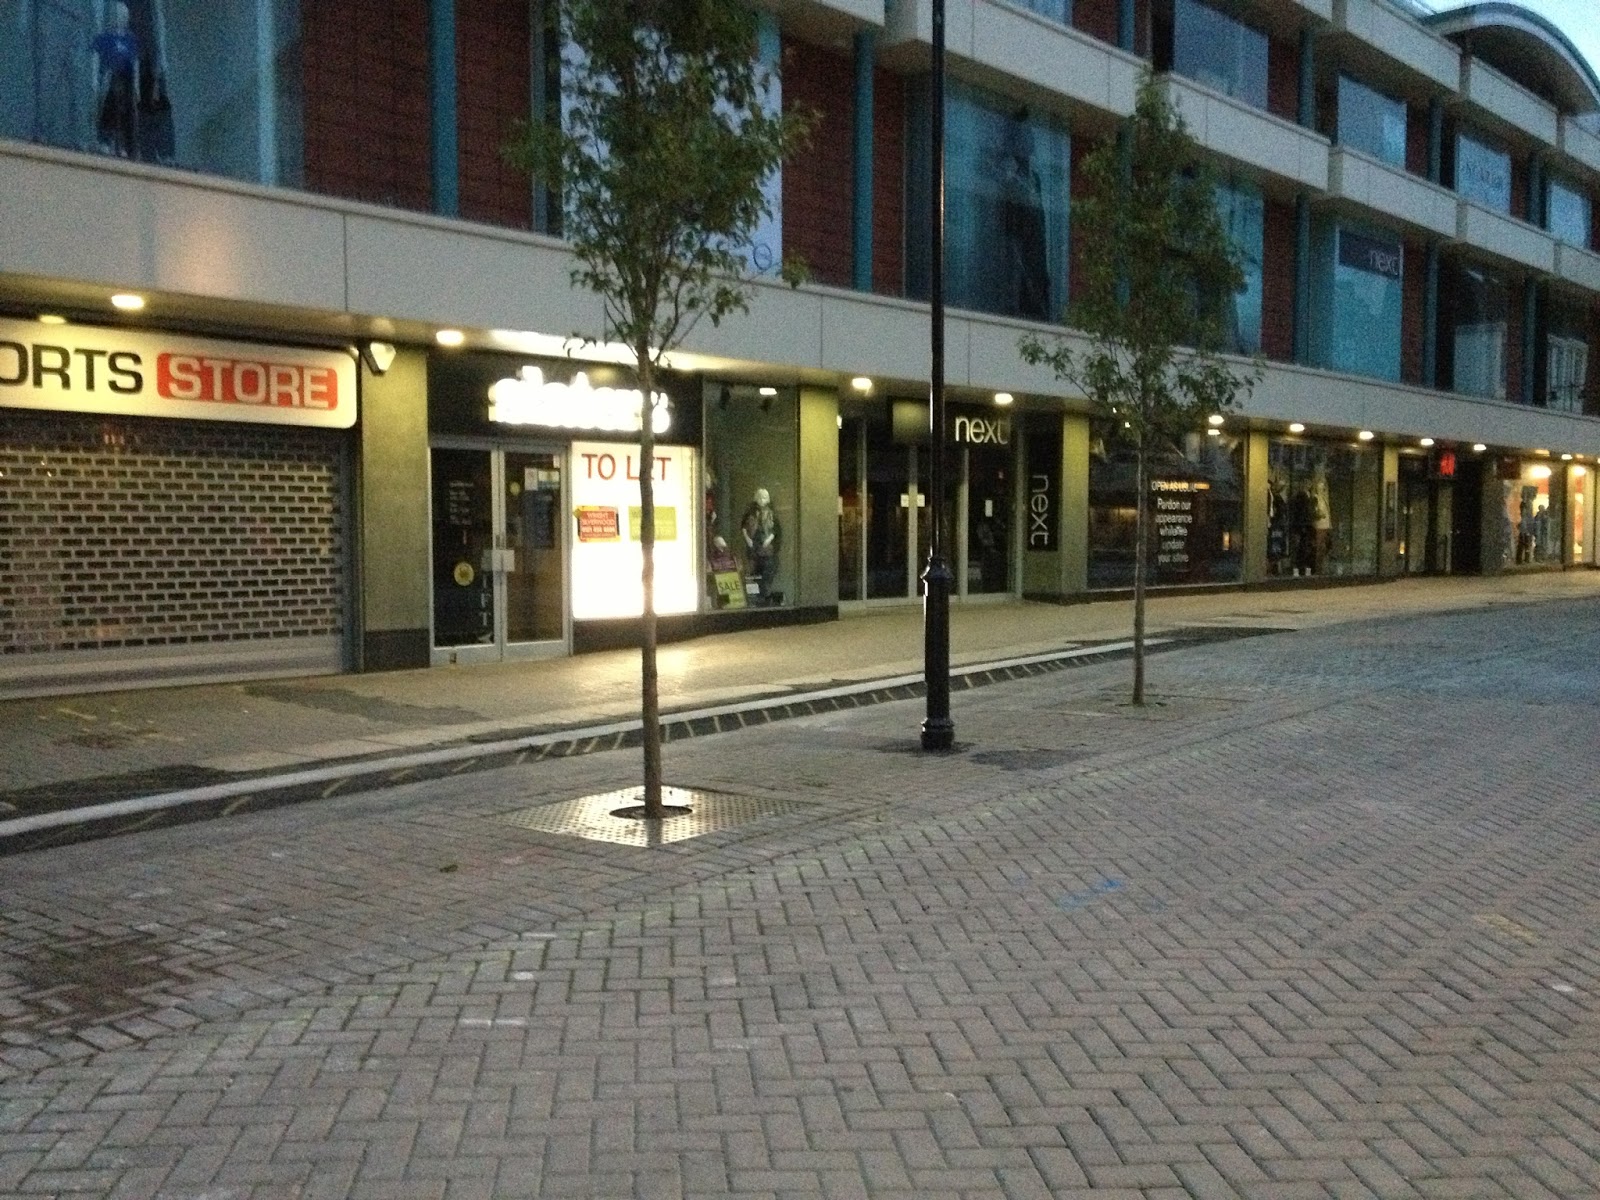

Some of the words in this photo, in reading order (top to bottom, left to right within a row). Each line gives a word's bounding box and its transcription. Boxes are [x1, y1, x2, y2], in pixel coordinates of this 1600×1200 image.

[168, 354, 329, 408] STORE
[955, 415, 1009, 445] next
[582, 453, 616, 480] TO
[626, 456, 671, 481] LT
[1030, 474, 1049, 545] next
[718, 579, 741, 592] SALE
